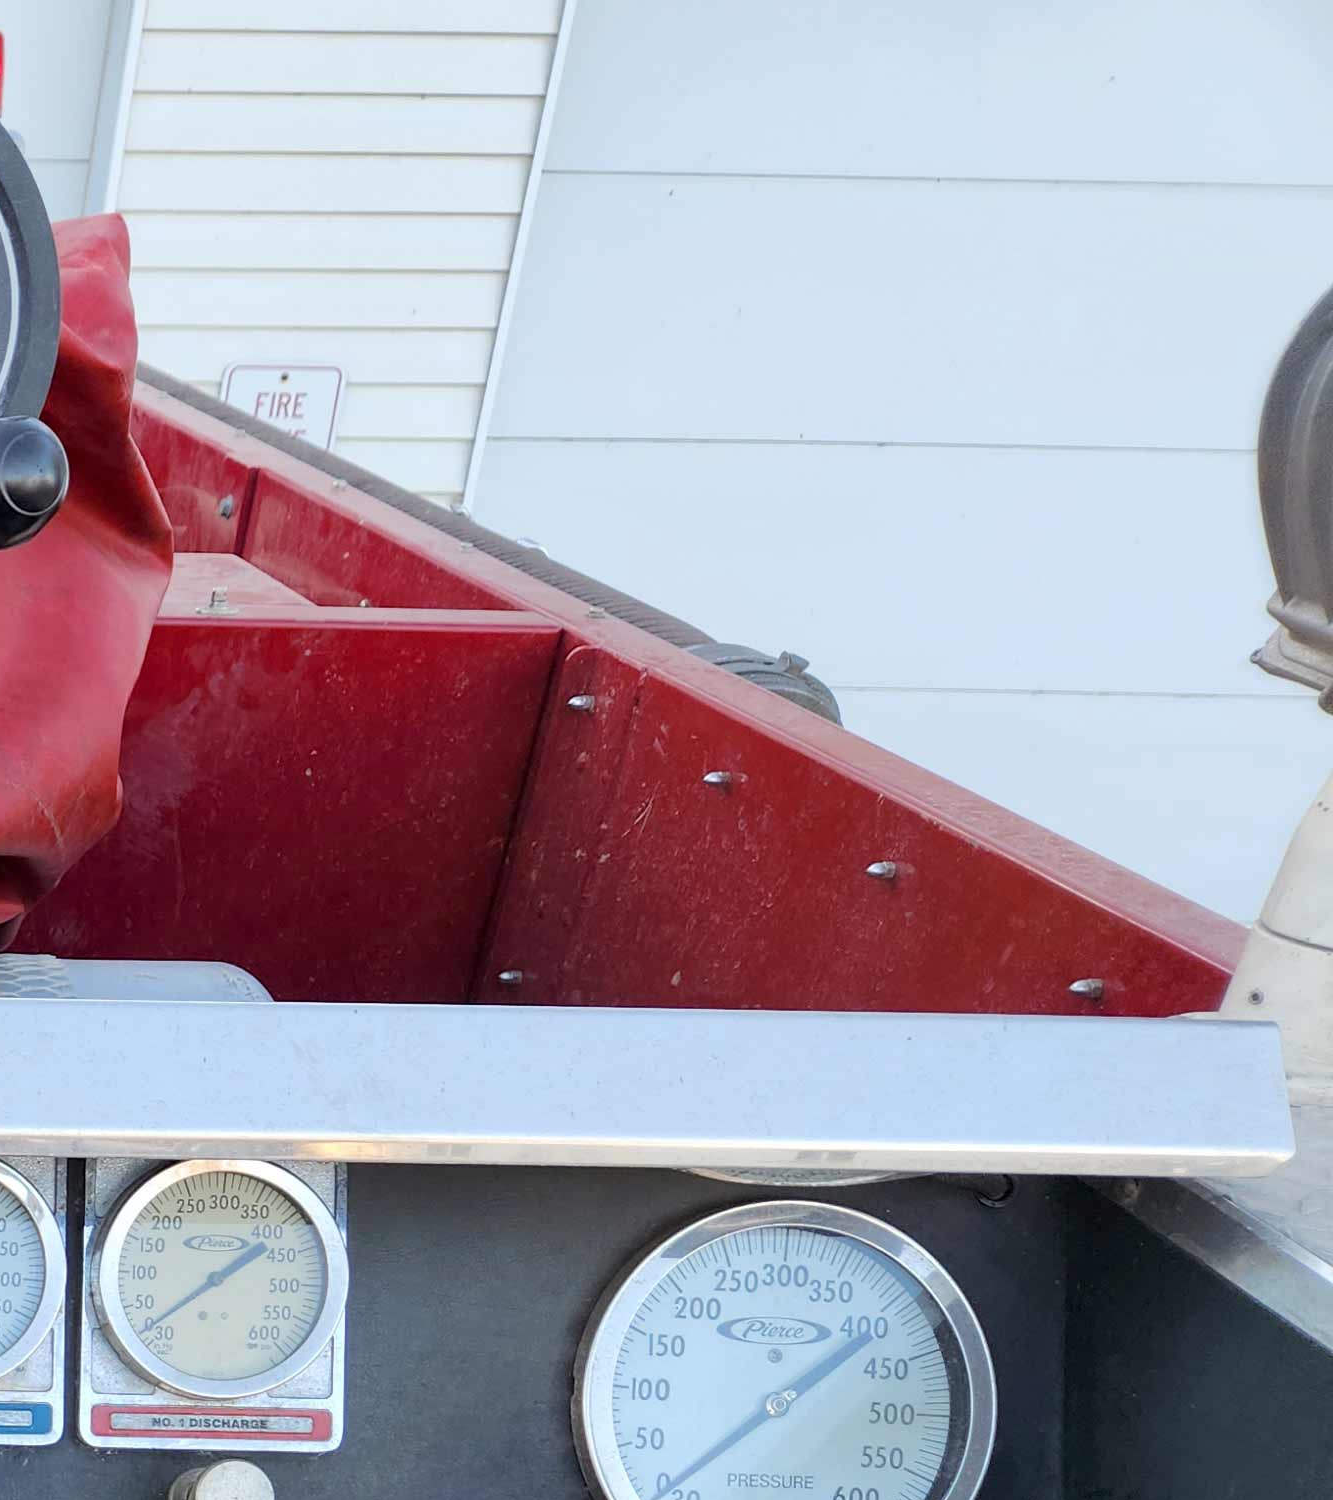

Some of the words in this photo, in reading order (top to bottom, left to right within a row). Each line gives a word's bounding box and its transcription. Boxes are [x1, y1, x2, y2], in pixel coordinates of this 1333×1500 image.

[254, 392, 307, 419] FIRE
[714, 1270, 759, 1293] 250
[761, 1263, 809, 1287] 300
[808, 1280, 853, 1303] 350
[674, 1298, 721, 1321] 200
[742, 1320, 805, 1339] Pierce
[839, 1316, 888, 1339] 400
[647, 1335, 685, 1357] 150
[863, 1358, 909, 1380] 450
[631, 1378, 670, 1401] 100
[152, 1417, 175, 1428] NO.
[189, 1418, 268, 1429] DISCHARGE
[868, 1402, 914, 1425] 500
[635, 1427, 664, 1450] 50
[860, 1447, 903, 1469] 550
[727, 1474, 814, 1490] PRESSURE
